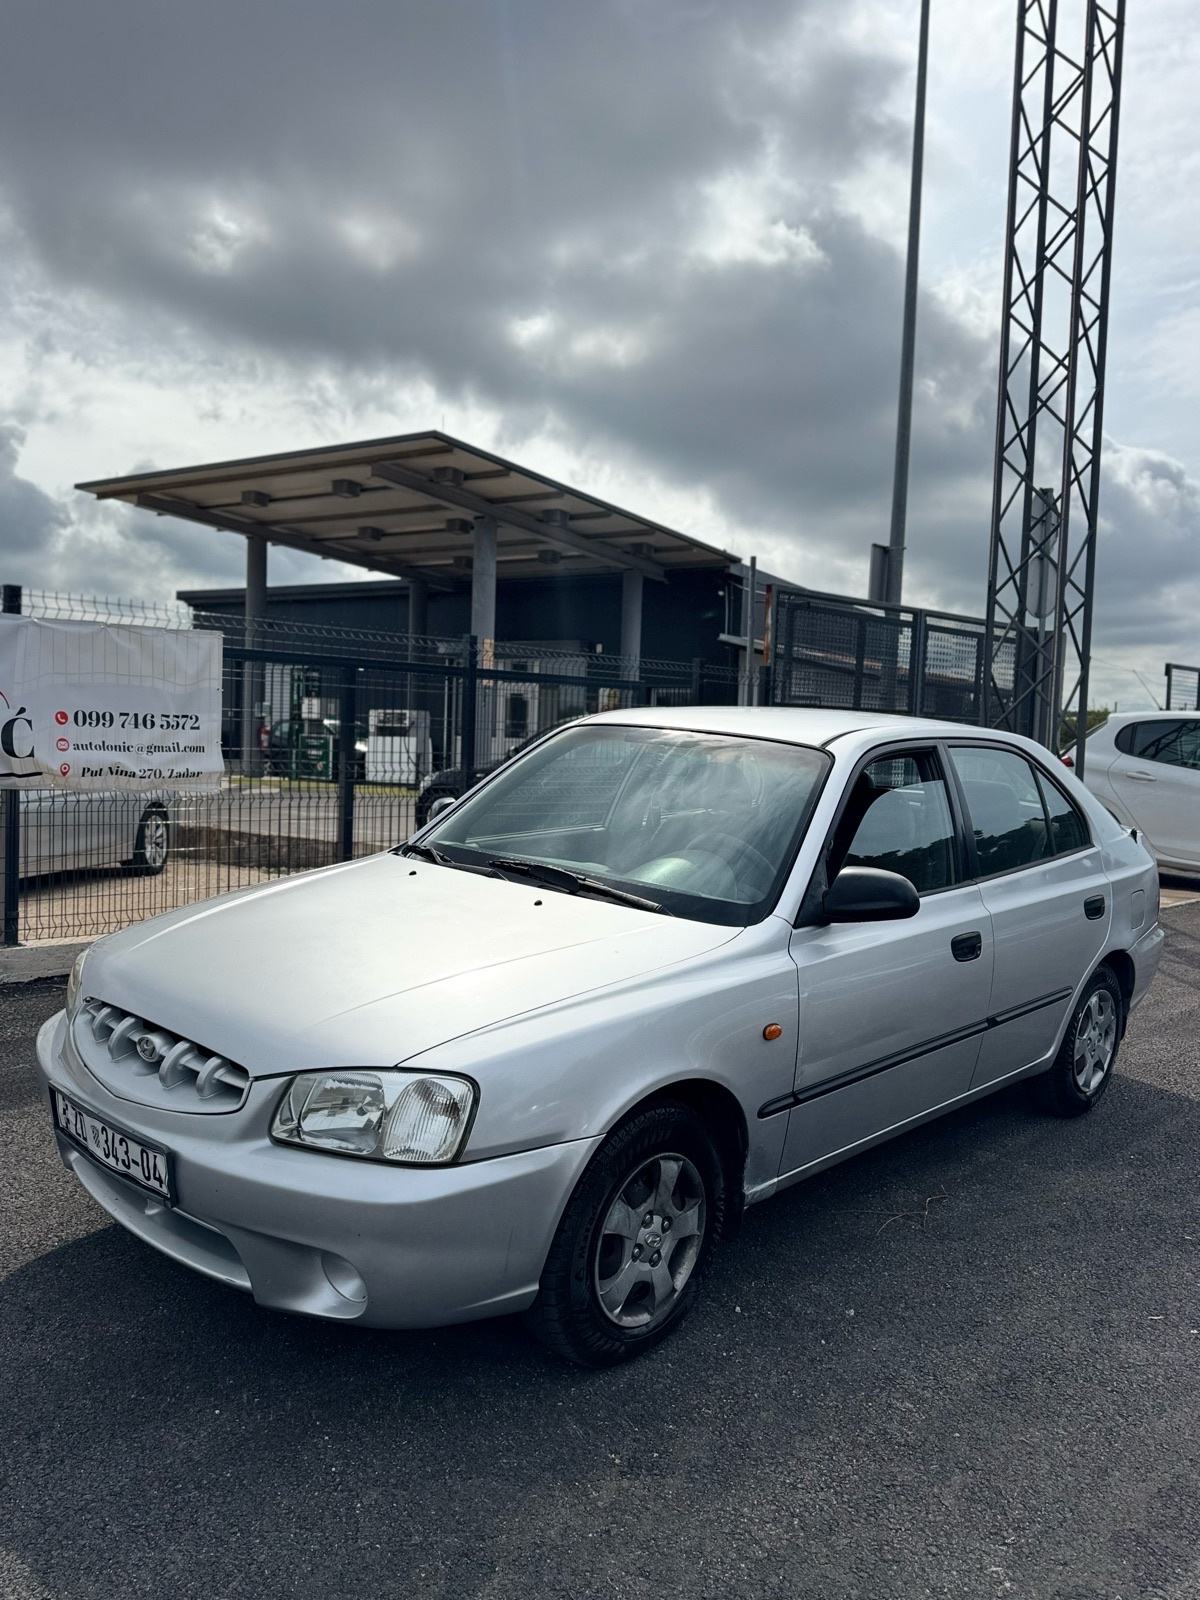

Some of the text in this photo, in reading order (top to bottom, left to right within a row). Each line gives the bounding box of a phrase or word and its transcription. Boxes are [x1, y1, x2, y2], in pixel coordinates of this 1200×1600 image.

[73, 709, 200, 731] 099 746 5572
[81, 767, 103, 778] Put
[167, 767, 203, 779] Zadar
[101, 1125, 164, 1188] 343-04
